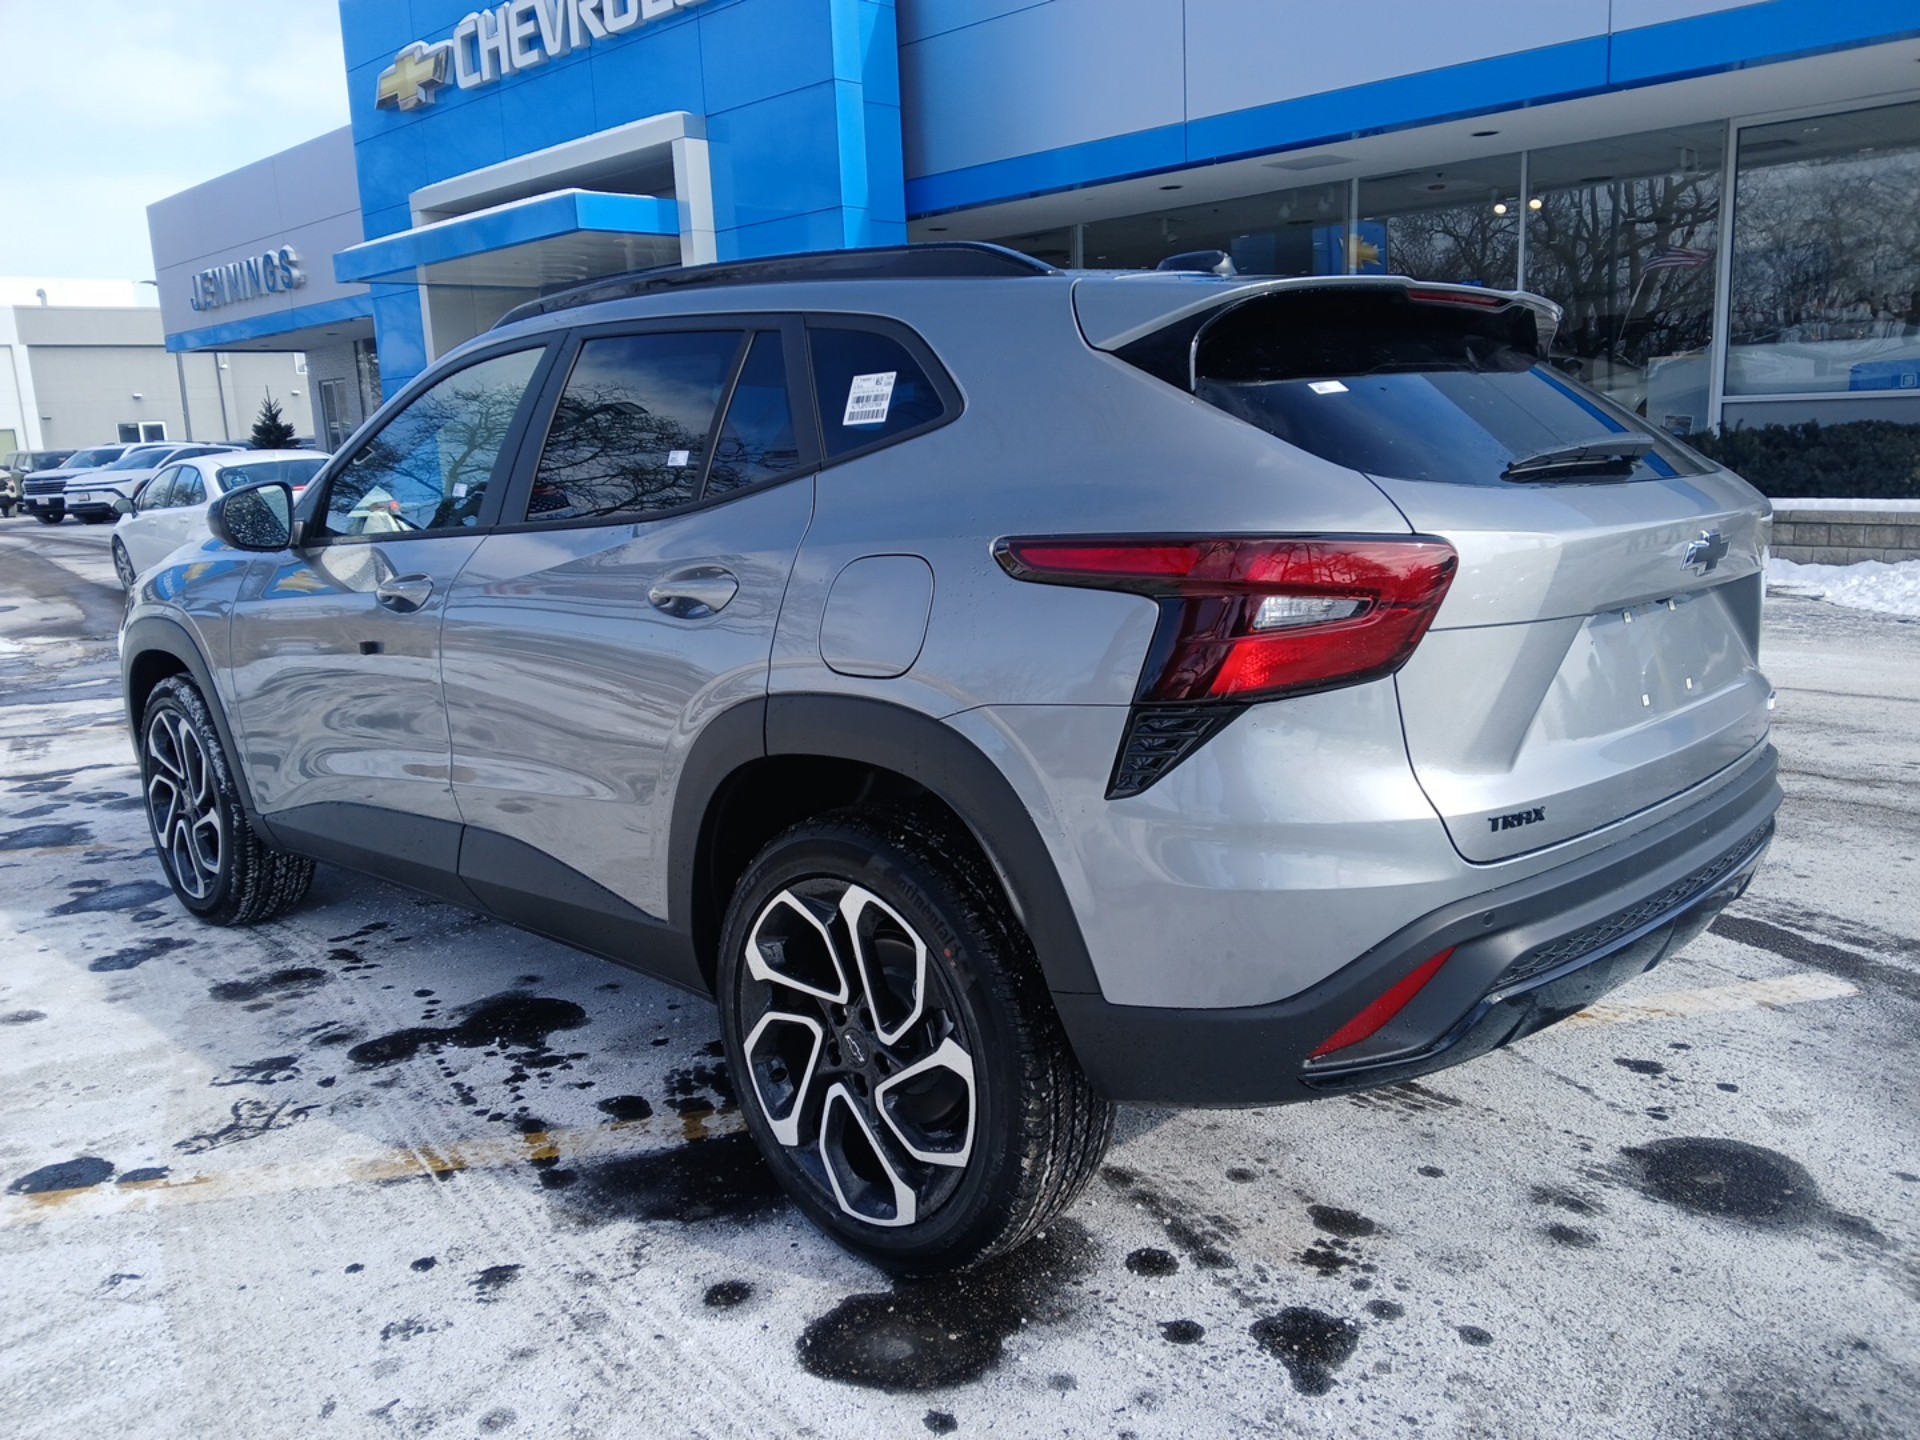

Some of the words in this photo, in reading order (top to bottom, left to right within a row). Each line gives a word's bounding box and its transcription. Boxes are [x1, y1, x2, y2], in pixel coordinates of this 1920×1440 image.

[190, 245, 306, 311] JENNINGS
[1488, 806, 1546, 832] TRAX
[889, 866, 956, 947] ntinental
